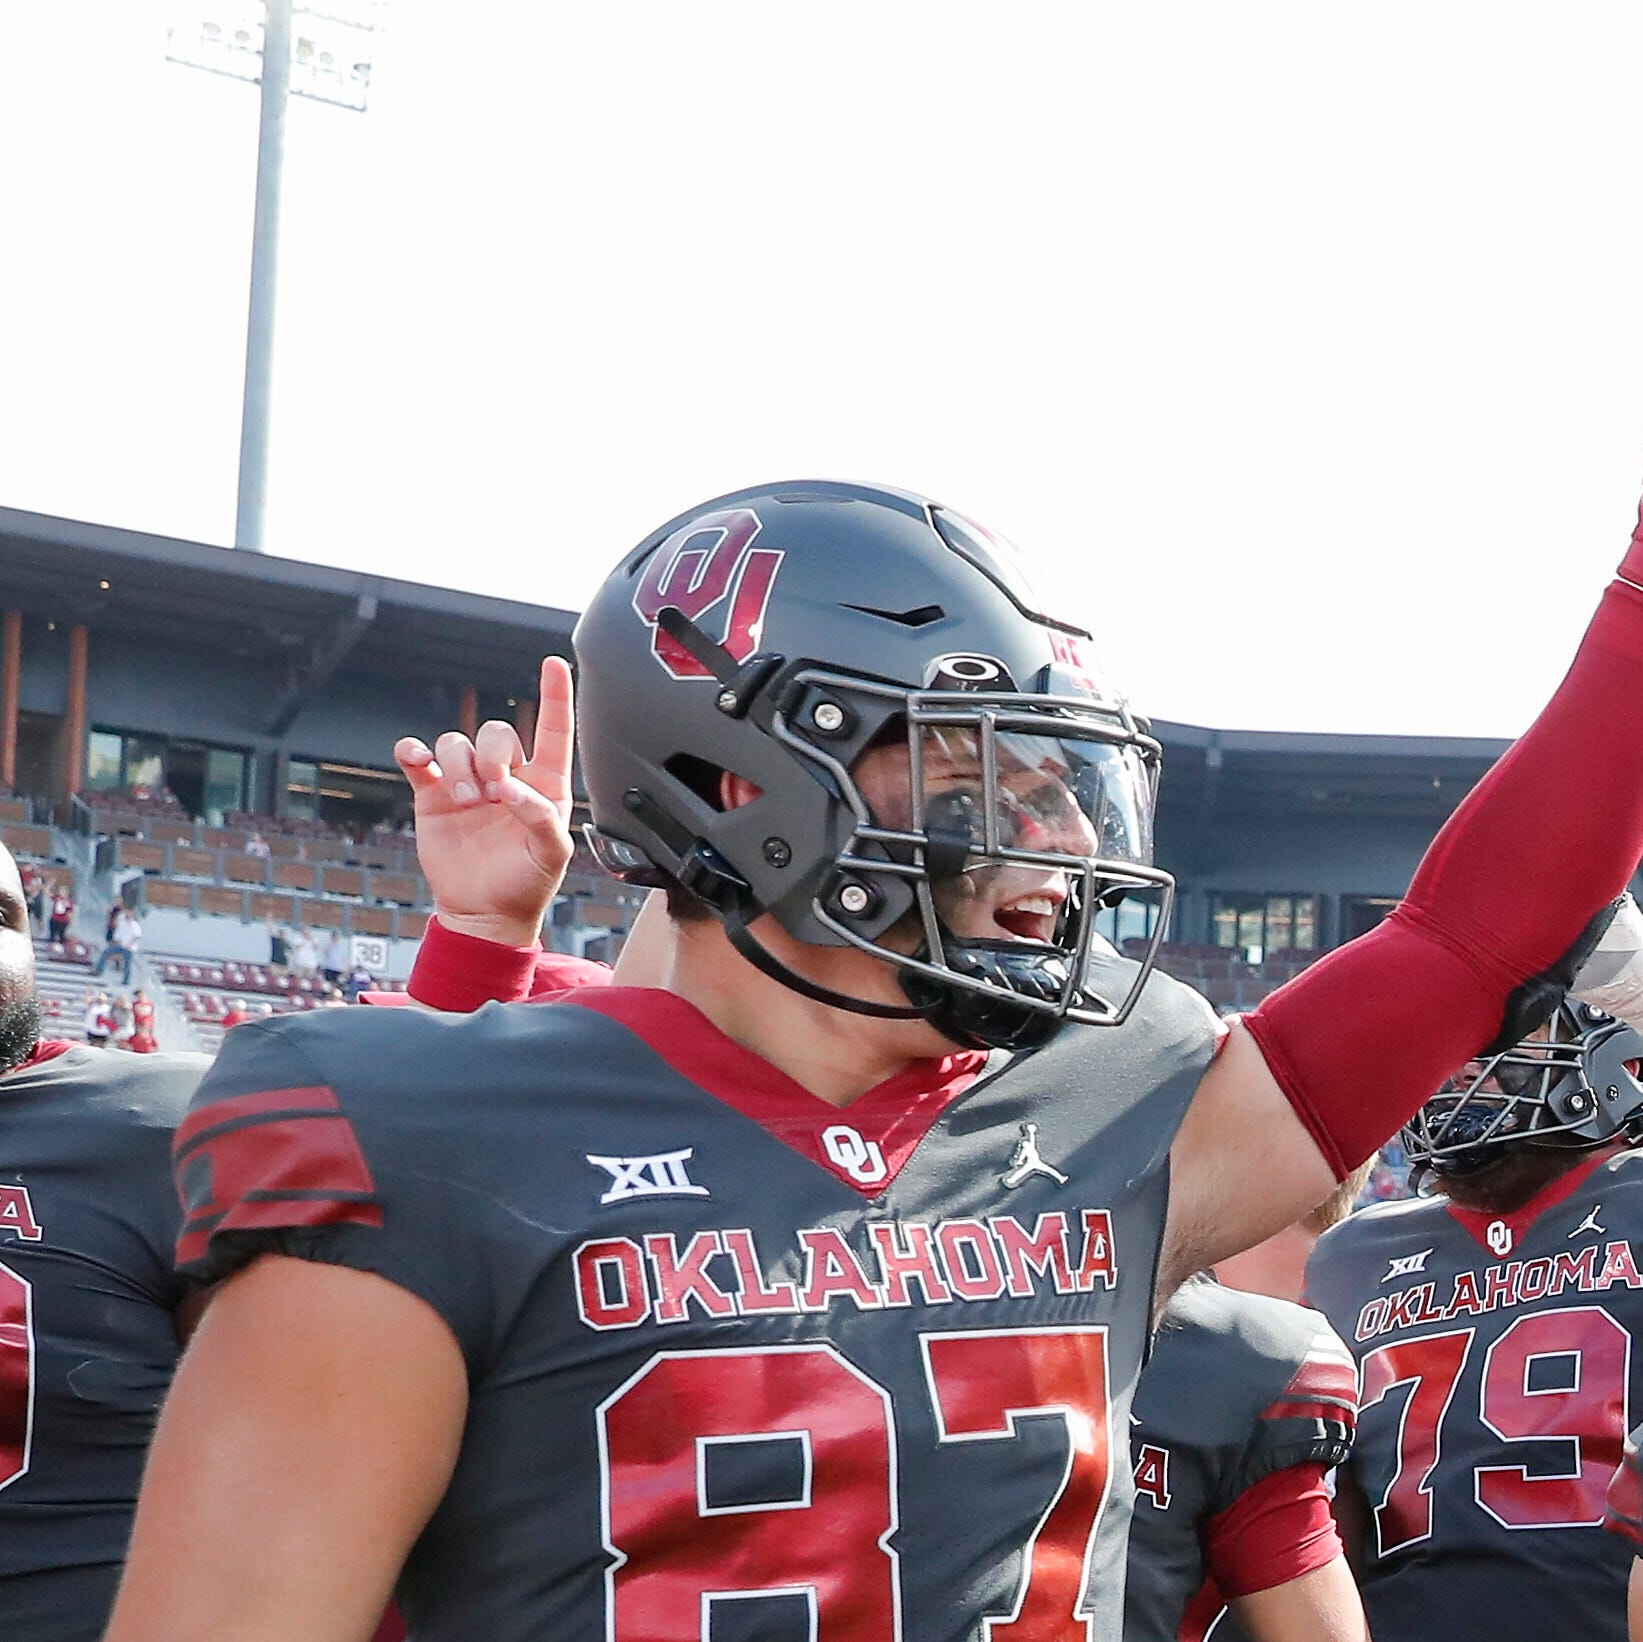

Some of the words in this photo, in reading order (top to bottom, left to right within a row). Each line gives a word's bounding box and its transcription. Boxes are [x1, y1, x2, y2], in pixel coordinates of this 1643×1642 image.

[821, 1125, 888, 1186] OU
[571, 1208, 1119, 1332] OKLAHOMA
[1486, 1220, 1512, 1256] OU
[1354, 1239, 1643, 1343] OKLAHOMA
[1357, 1304, 1632, 1560] 79
